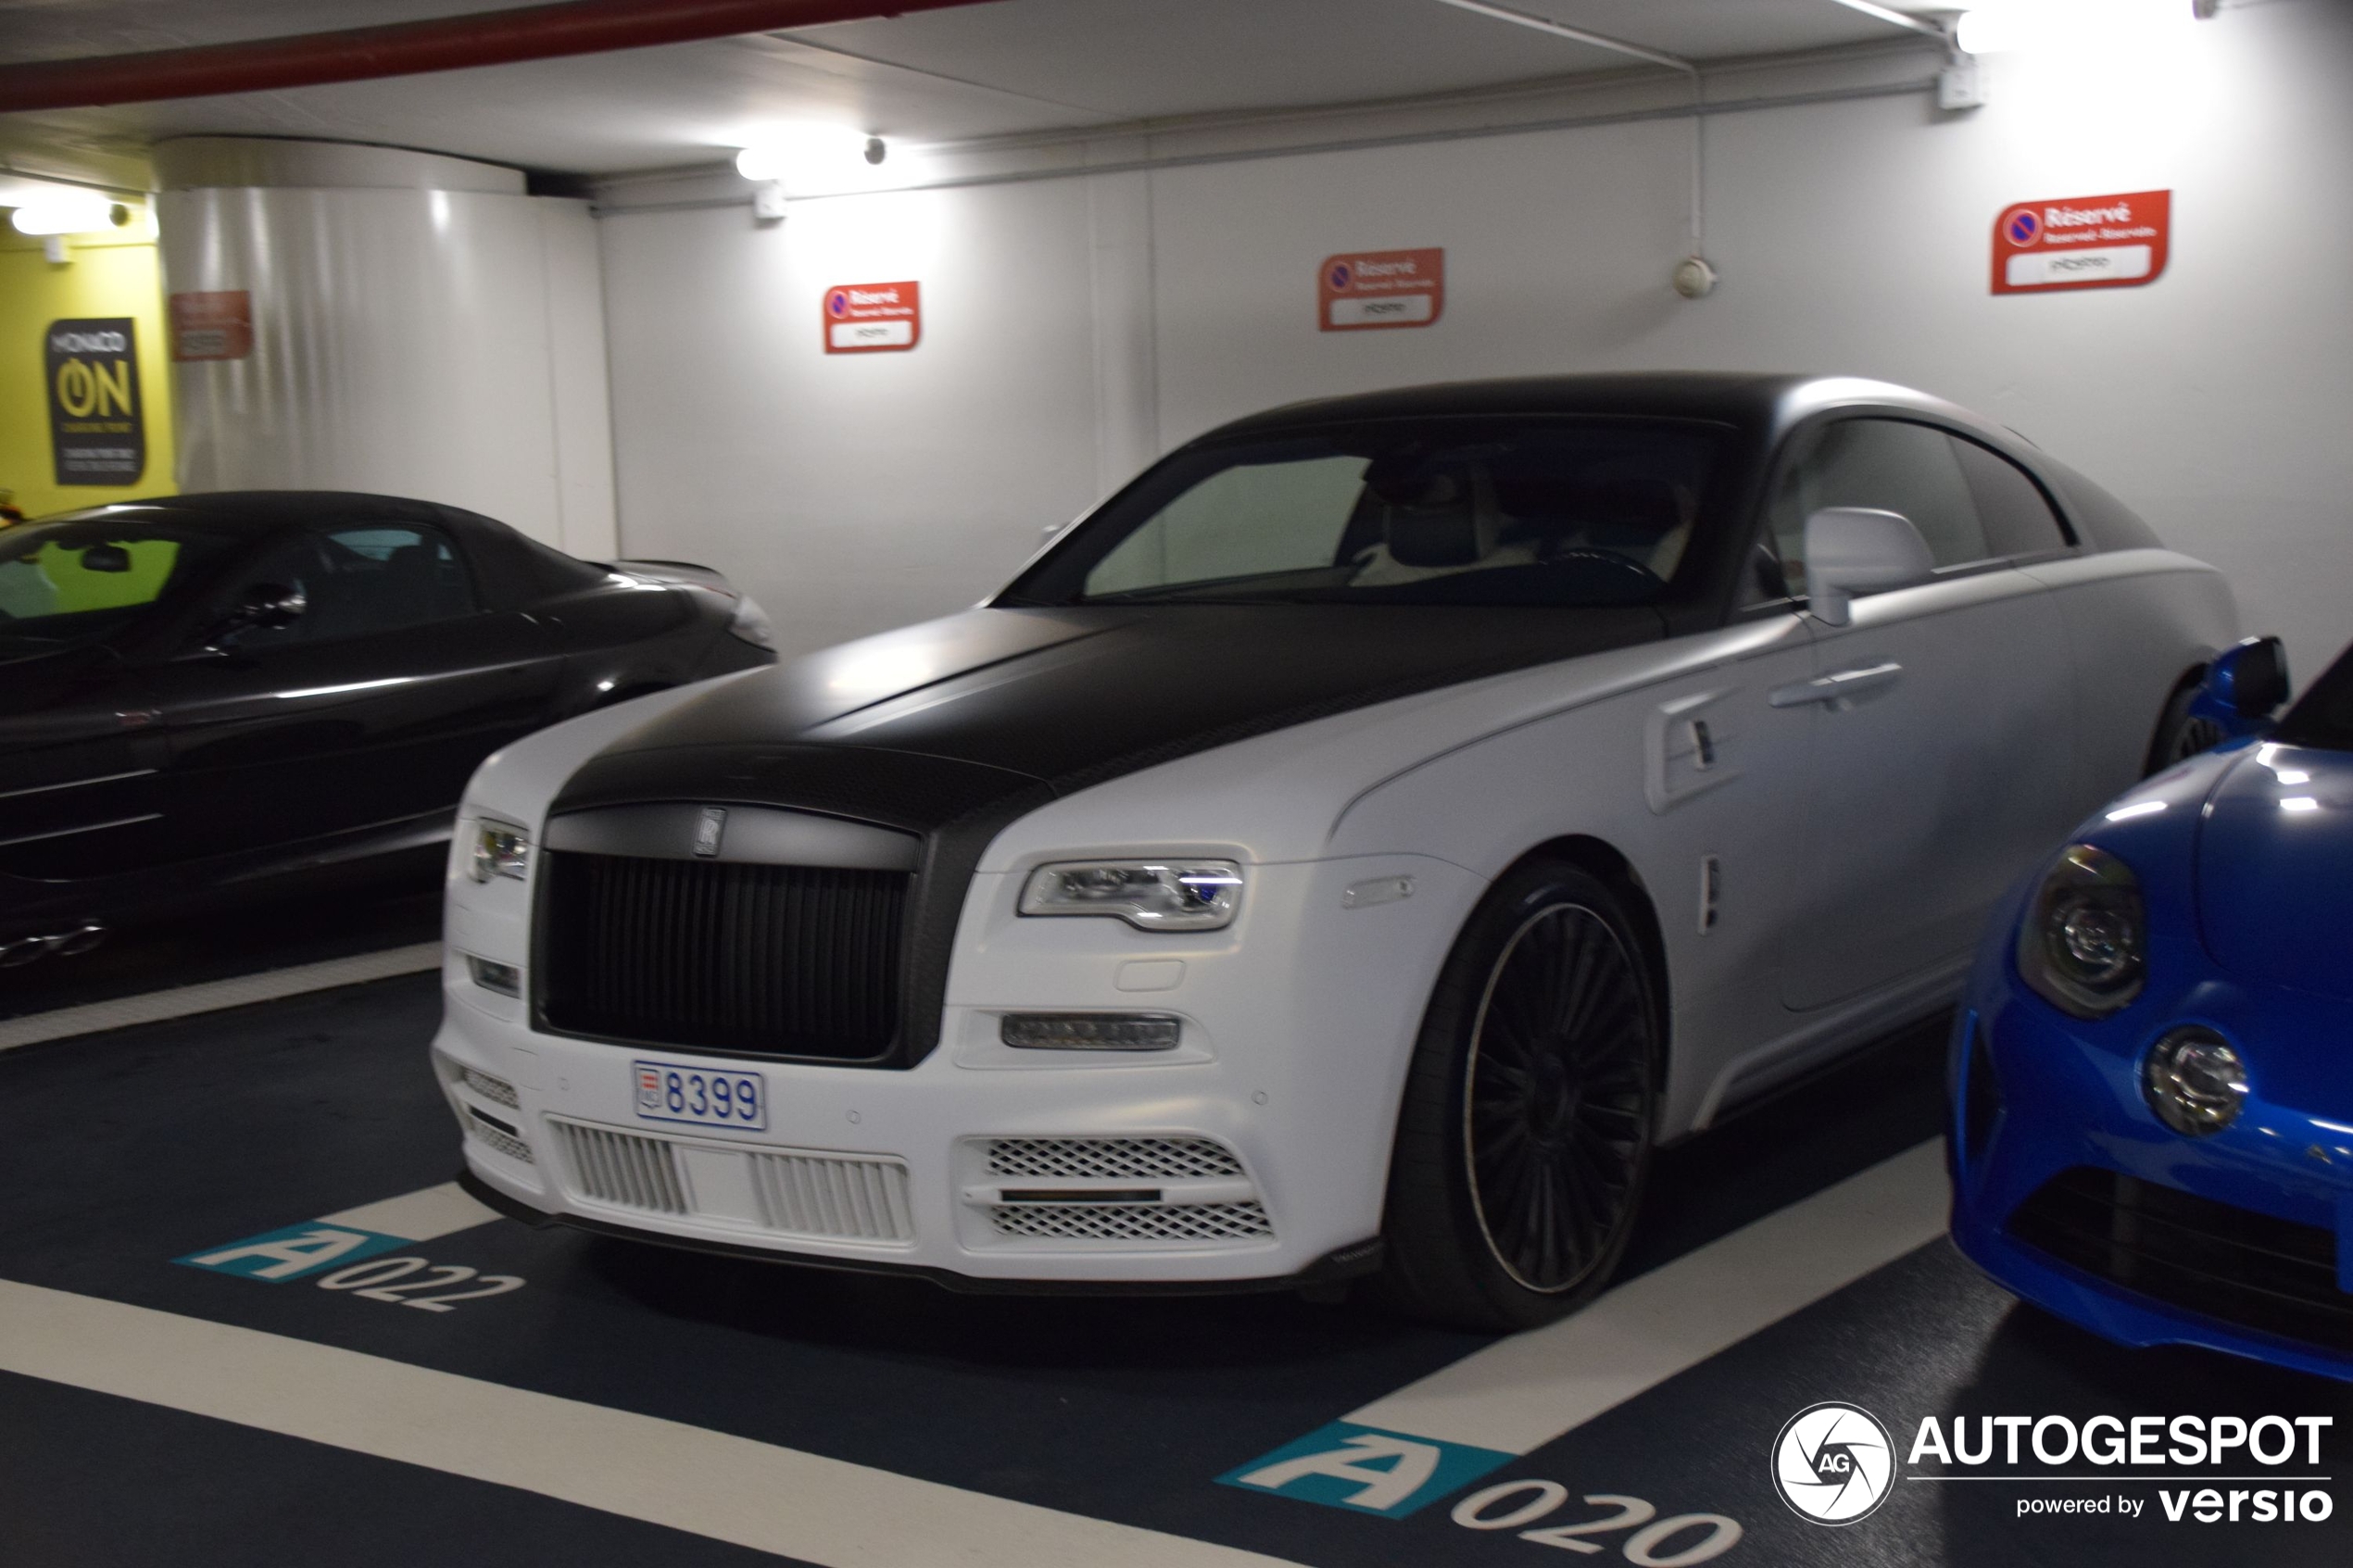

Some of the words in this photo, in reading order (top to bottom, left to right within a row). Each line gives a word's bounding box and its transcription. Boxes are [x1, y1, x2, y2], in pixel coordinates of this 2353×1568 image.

[2044, 201, 2132, 228] Réservé
[52, 332, 126, 352] MONACO
[57, 358, 132, 417] ON
[667, 1073, 757, 1121] 8399
[190, 1229, 370, 1279] A
[317, 1256, 526, 1312] 022
[1237, 1434, 1441, 1511] A
[1450, 1479, 1743, 1568] 020
